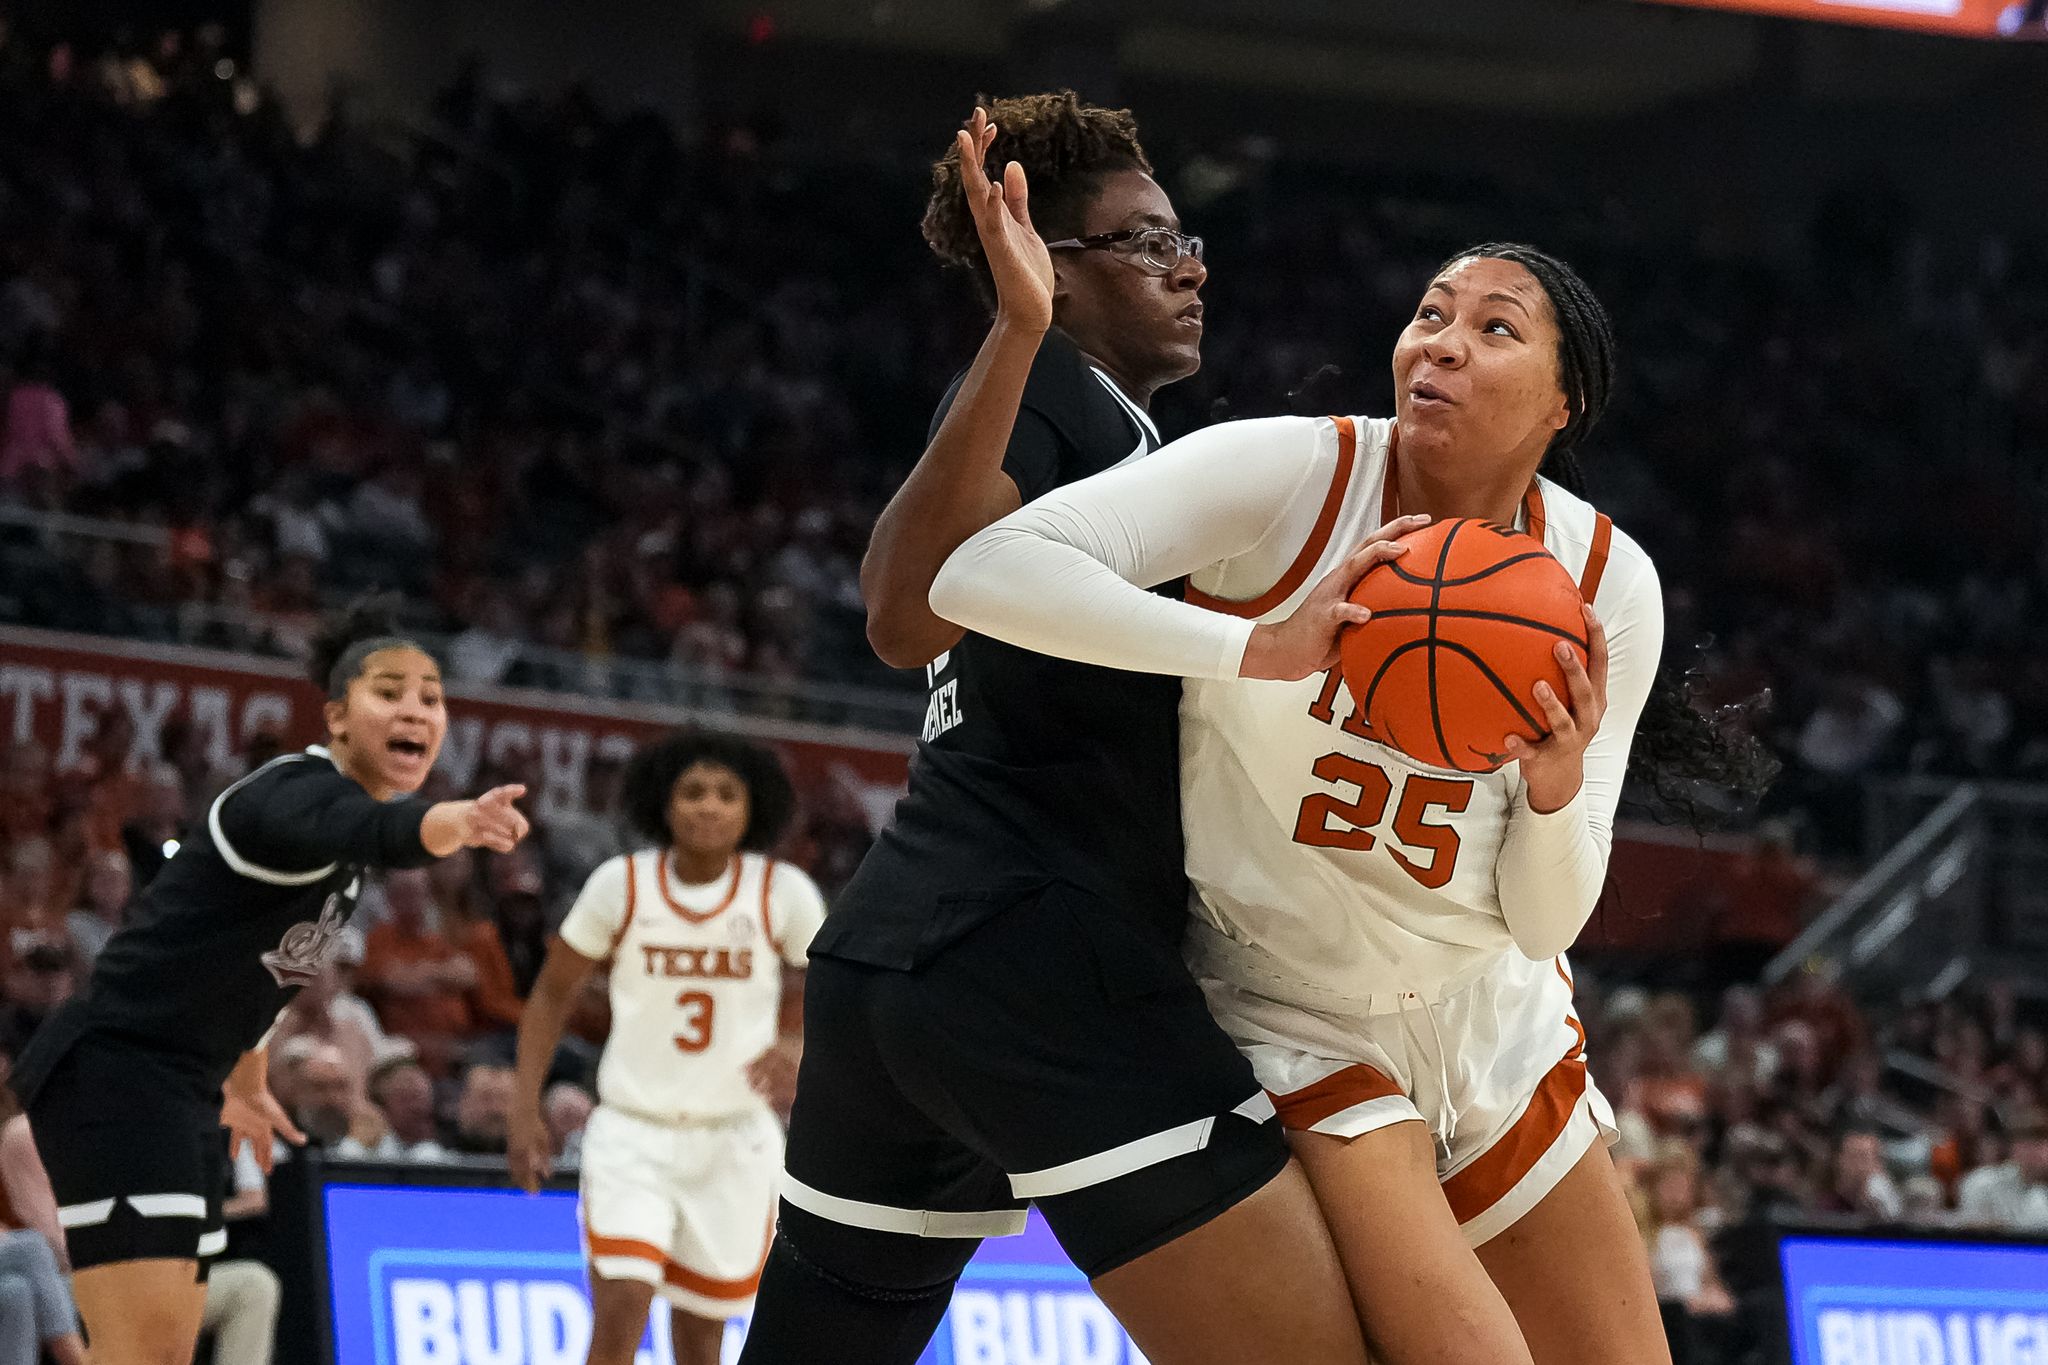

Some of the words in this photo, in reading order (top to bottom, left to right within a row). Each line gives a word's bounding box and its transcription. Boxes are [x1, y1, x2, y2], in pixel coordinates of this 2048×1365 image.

[1292, 751, 1474, 889] 25
[641, 944, 753, 979] TEXAS
[675, 991, 713, 1052] 3
[391, 1278, 594, 1365] BUD
[951, 1289, 1124, 1365] BUD
